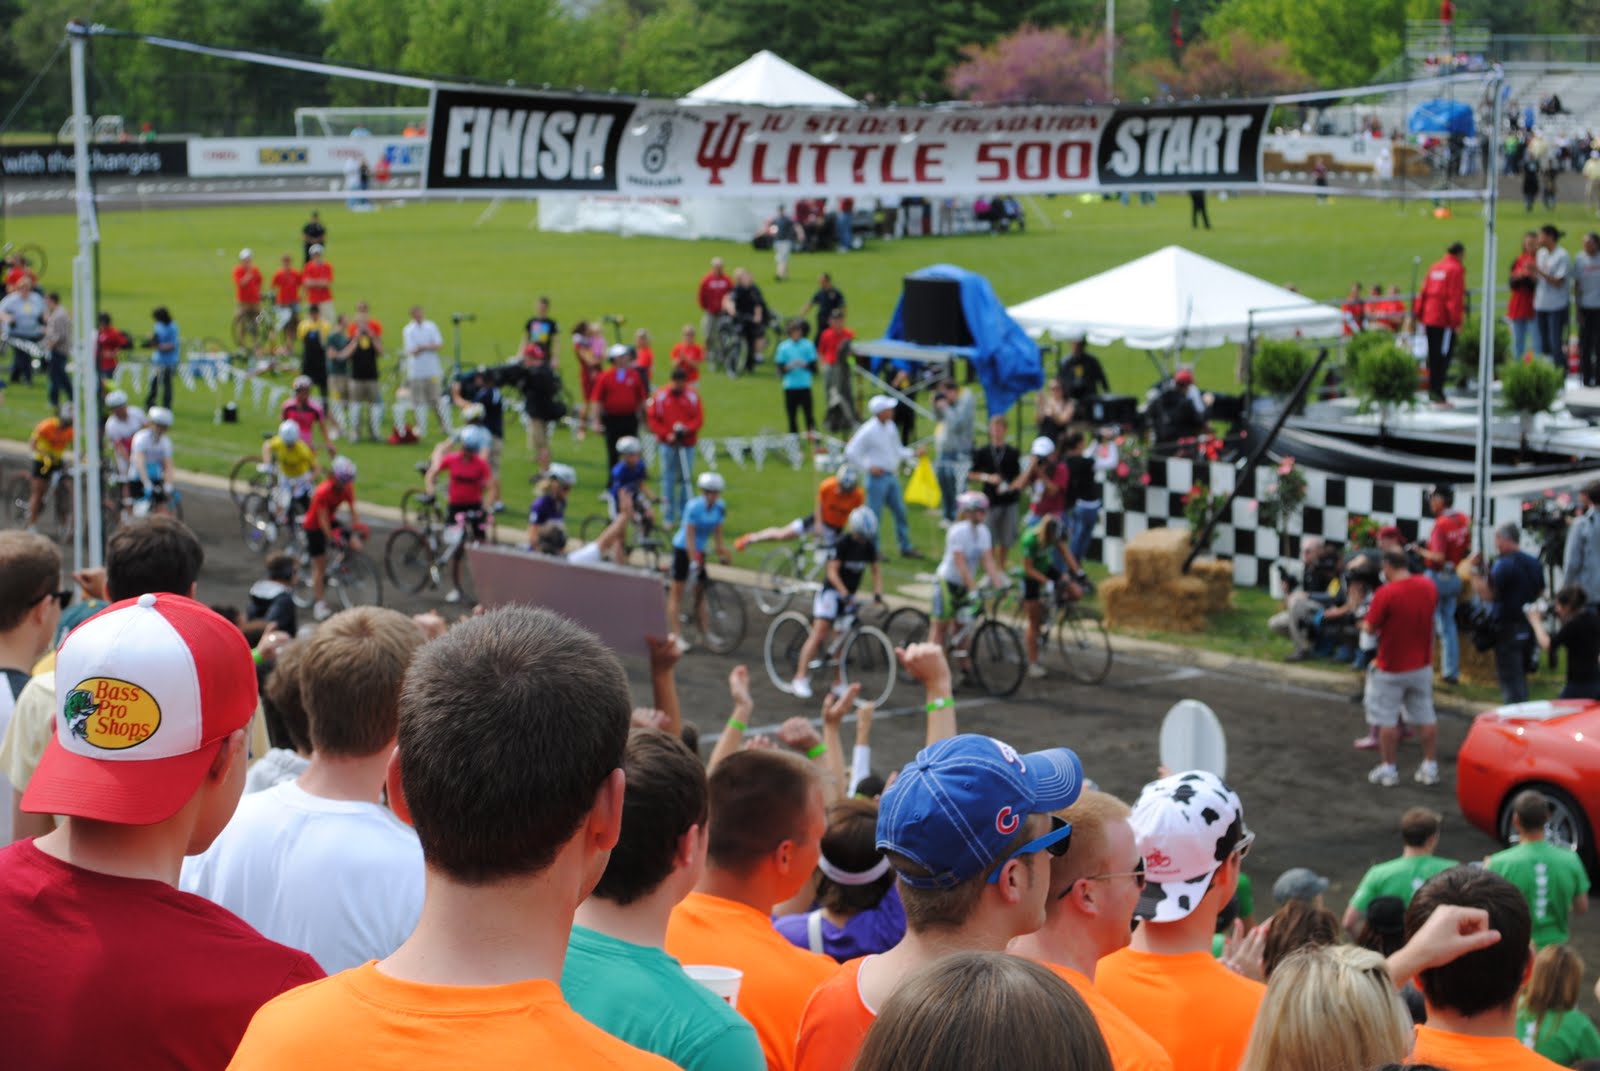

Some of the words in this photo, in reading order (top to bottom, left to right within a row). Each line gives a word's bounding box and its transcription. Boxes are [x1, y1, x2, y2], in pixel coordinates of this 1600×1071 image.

[761, 113, 795, 132] IU
[803, 113, 932, 134] STUDENT
[940, 113, 1100, 134] FOUNDATION
[443, 106, 615, 180] FINISH
[1107, 114, 1253, 177] START
[2, 150, 45, 174] with
[751, 142, 946, 185] LITTLE
[976, 140, 1093, 182] 500
[95, 680, 140, 702] Bass
[97, 699, 128, 719] Pro
[95, 716, 151, 741] Shops
[995, 805, 1020, 835] C
